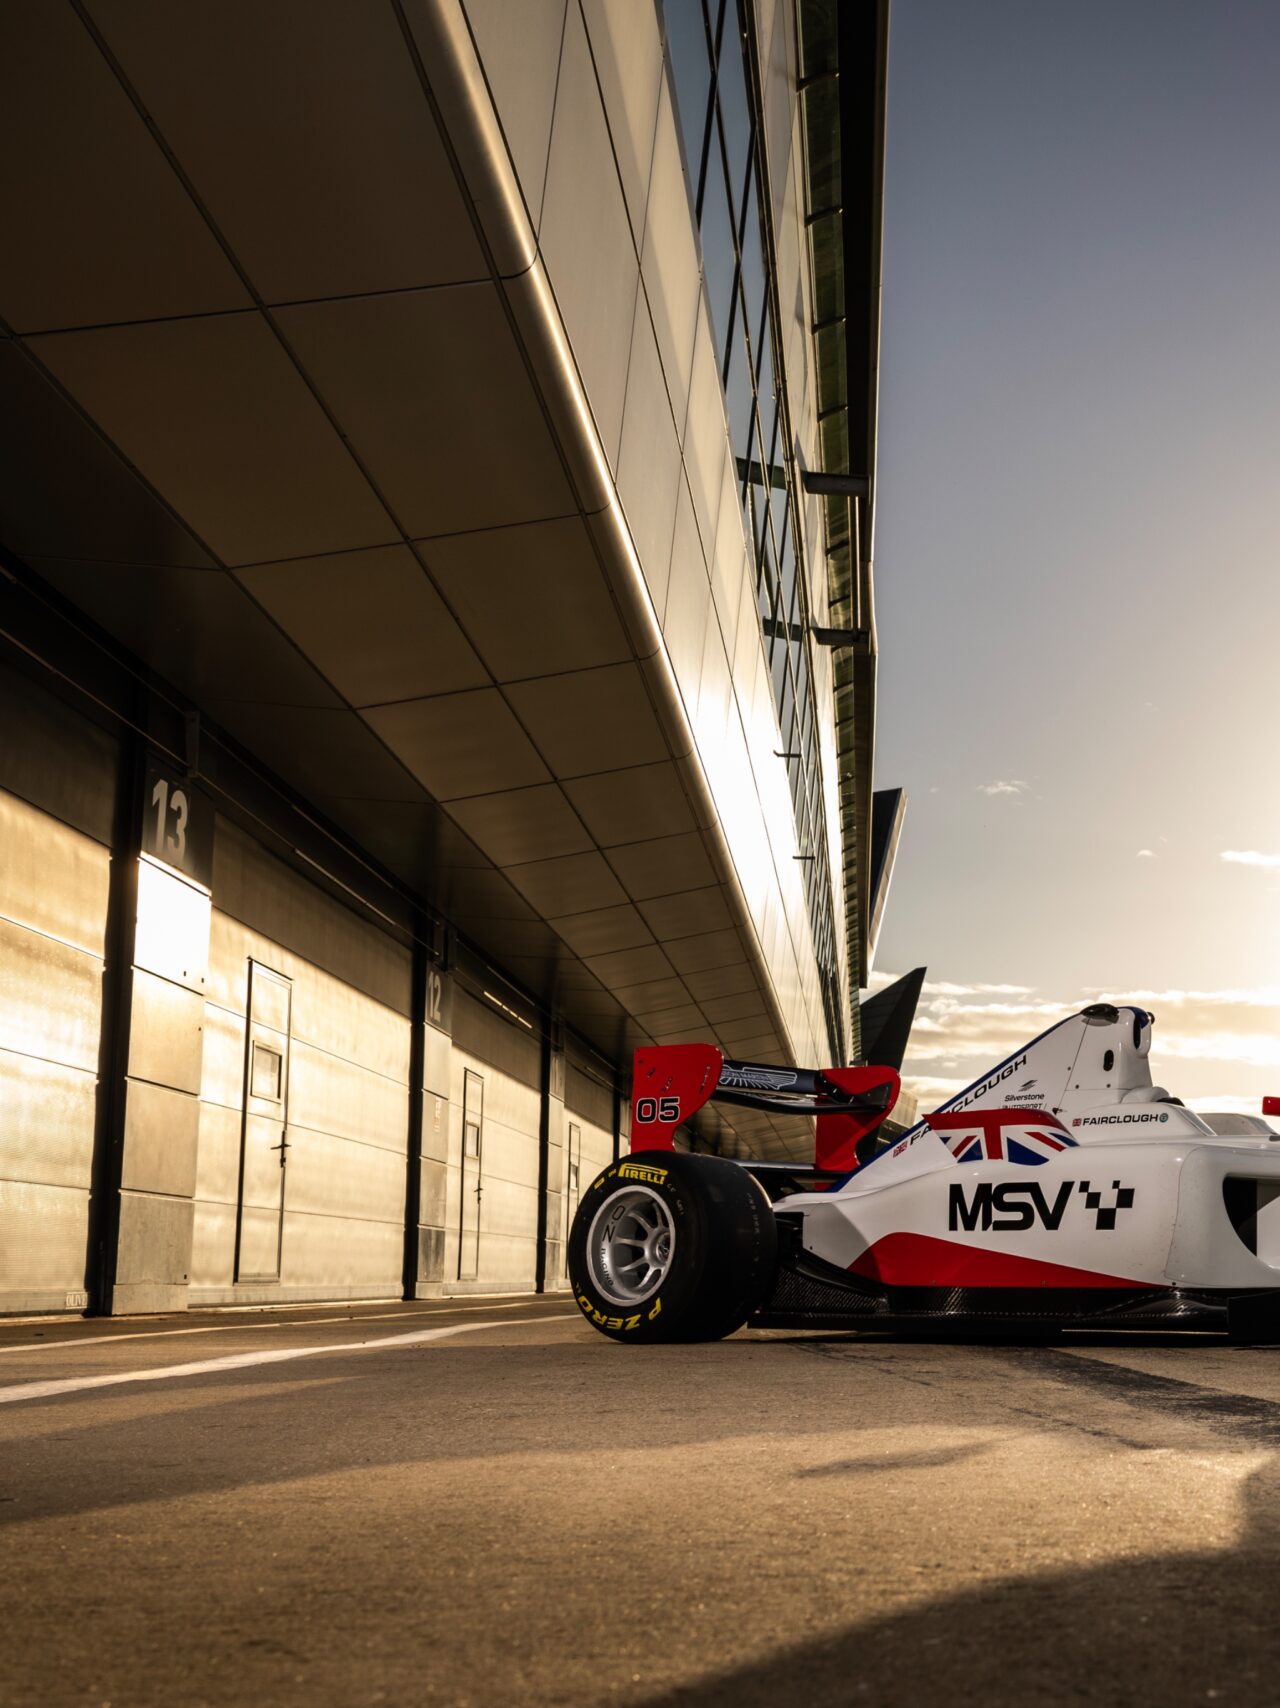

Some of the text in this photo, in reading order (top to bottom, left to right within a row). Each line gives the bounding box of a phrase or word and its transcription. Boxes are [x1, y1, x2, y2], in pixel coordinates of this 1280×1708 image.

[152, 779, 188, 868] 13
[428, 970, 441, 1022] 12
[636, 1097, 680, 1123] 05
[910, 1055, 1027, 1145] FACLOUGH
[1004, 1093, 1045, 1102] Silverstone
[1083, 1114, 1158, 1126] FAIRCLOUGH
[618, 1163, 669, 1185] PIRELLI
[949, 1181, 1075, 1231] MSV
[578, 1295, 641, 1330] ZERO
